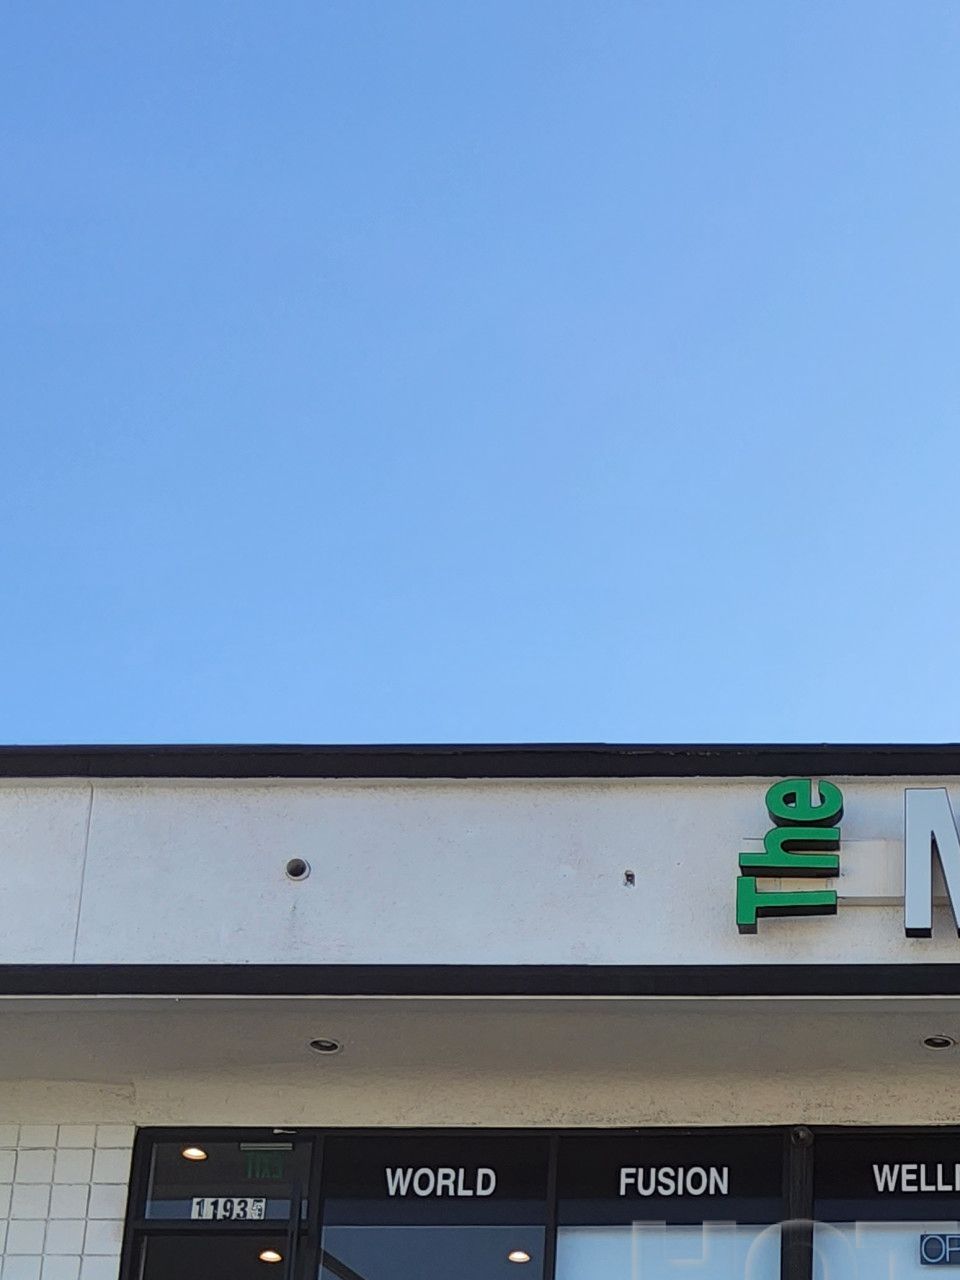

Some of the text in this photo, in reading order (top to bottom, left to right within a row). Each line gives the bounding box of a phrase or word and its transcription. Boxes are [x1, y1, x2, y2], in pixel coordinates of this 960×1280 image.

[736, 778, 843, 934] The
[386, 1166, 496, 1197] WORLD
[619, 1166, 729, 1197] FUSION
